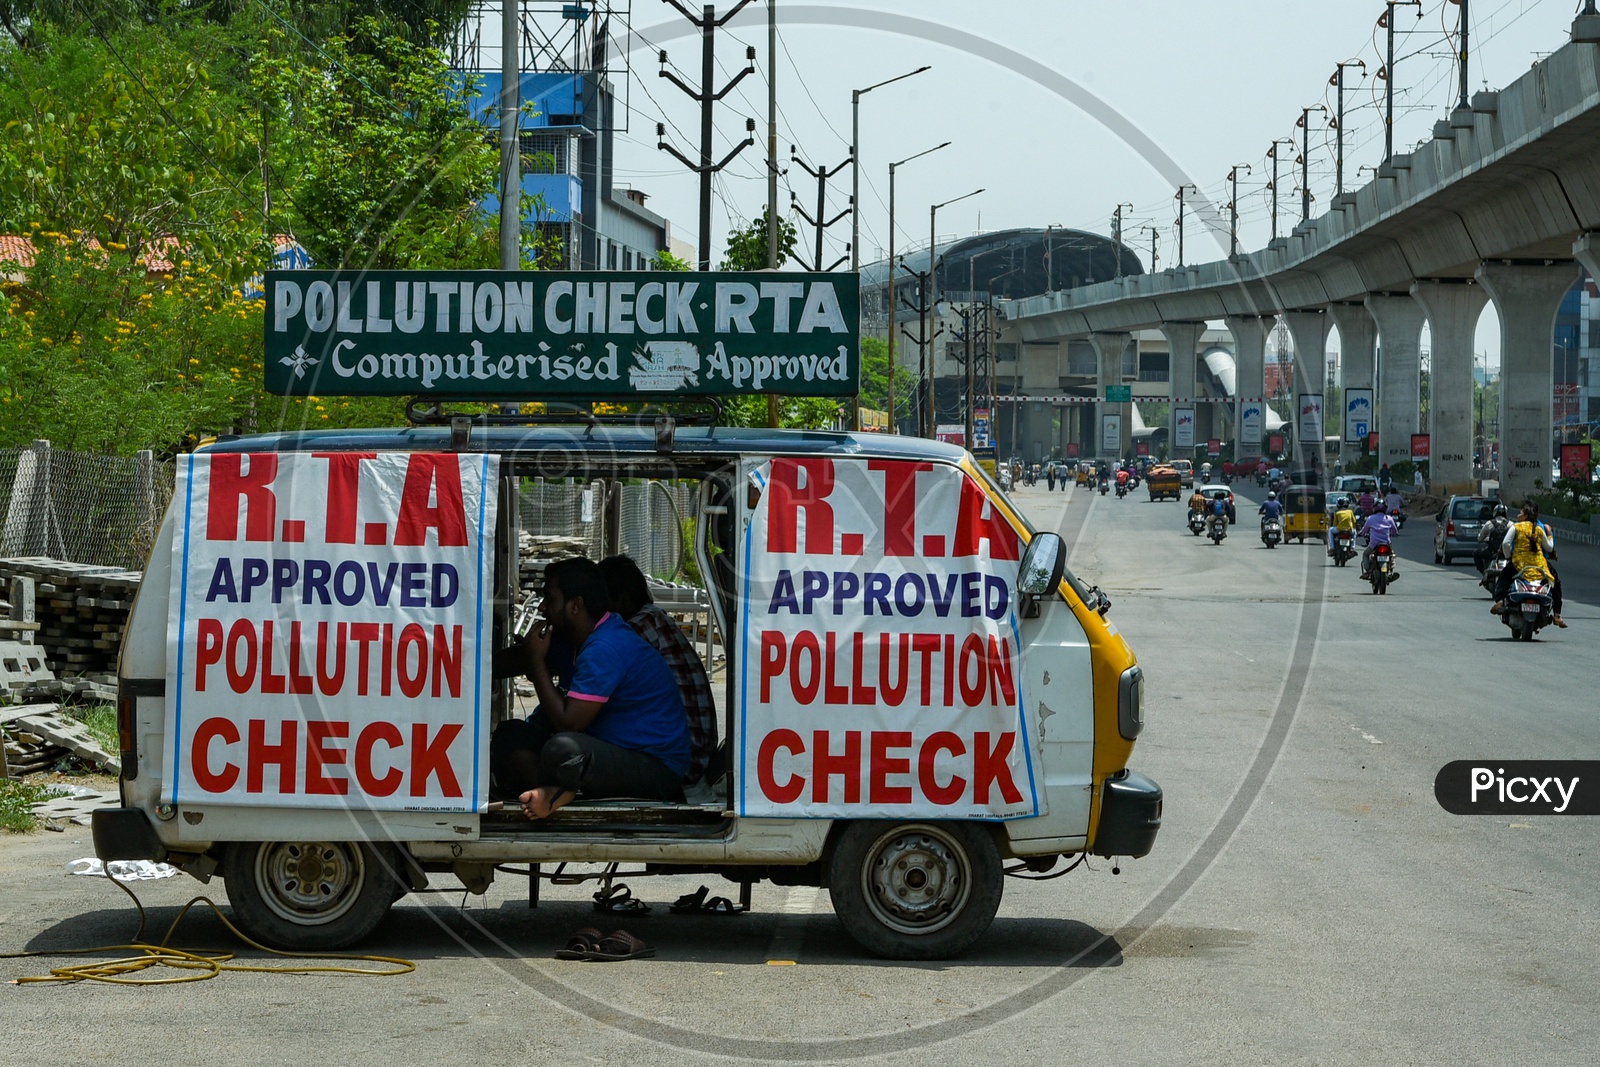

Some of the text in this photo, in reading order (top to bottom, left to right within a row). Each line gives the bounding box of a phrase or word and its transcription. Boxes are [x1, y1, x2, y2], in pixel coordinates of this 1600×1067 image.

[274, 281, 533, 334] POLLUTION
[332, 339, 850, 390] Computerised Approved
[206, 453, 469, 547] R.T.A
[1515, 461, 1540, 469] NUP-23A
[766, 458, 1020, 561] R.T.A
[205, 557, 460, 608] APPROVED
[768, 569, 1009, 620] APPROVED
[195, 618, 463, 699] POLLUTION
[760, 630, 1016, 707] POLLUTION
[191, 716, 465, 798] CHECK
[757, 728, 1024, 805] CHECK
